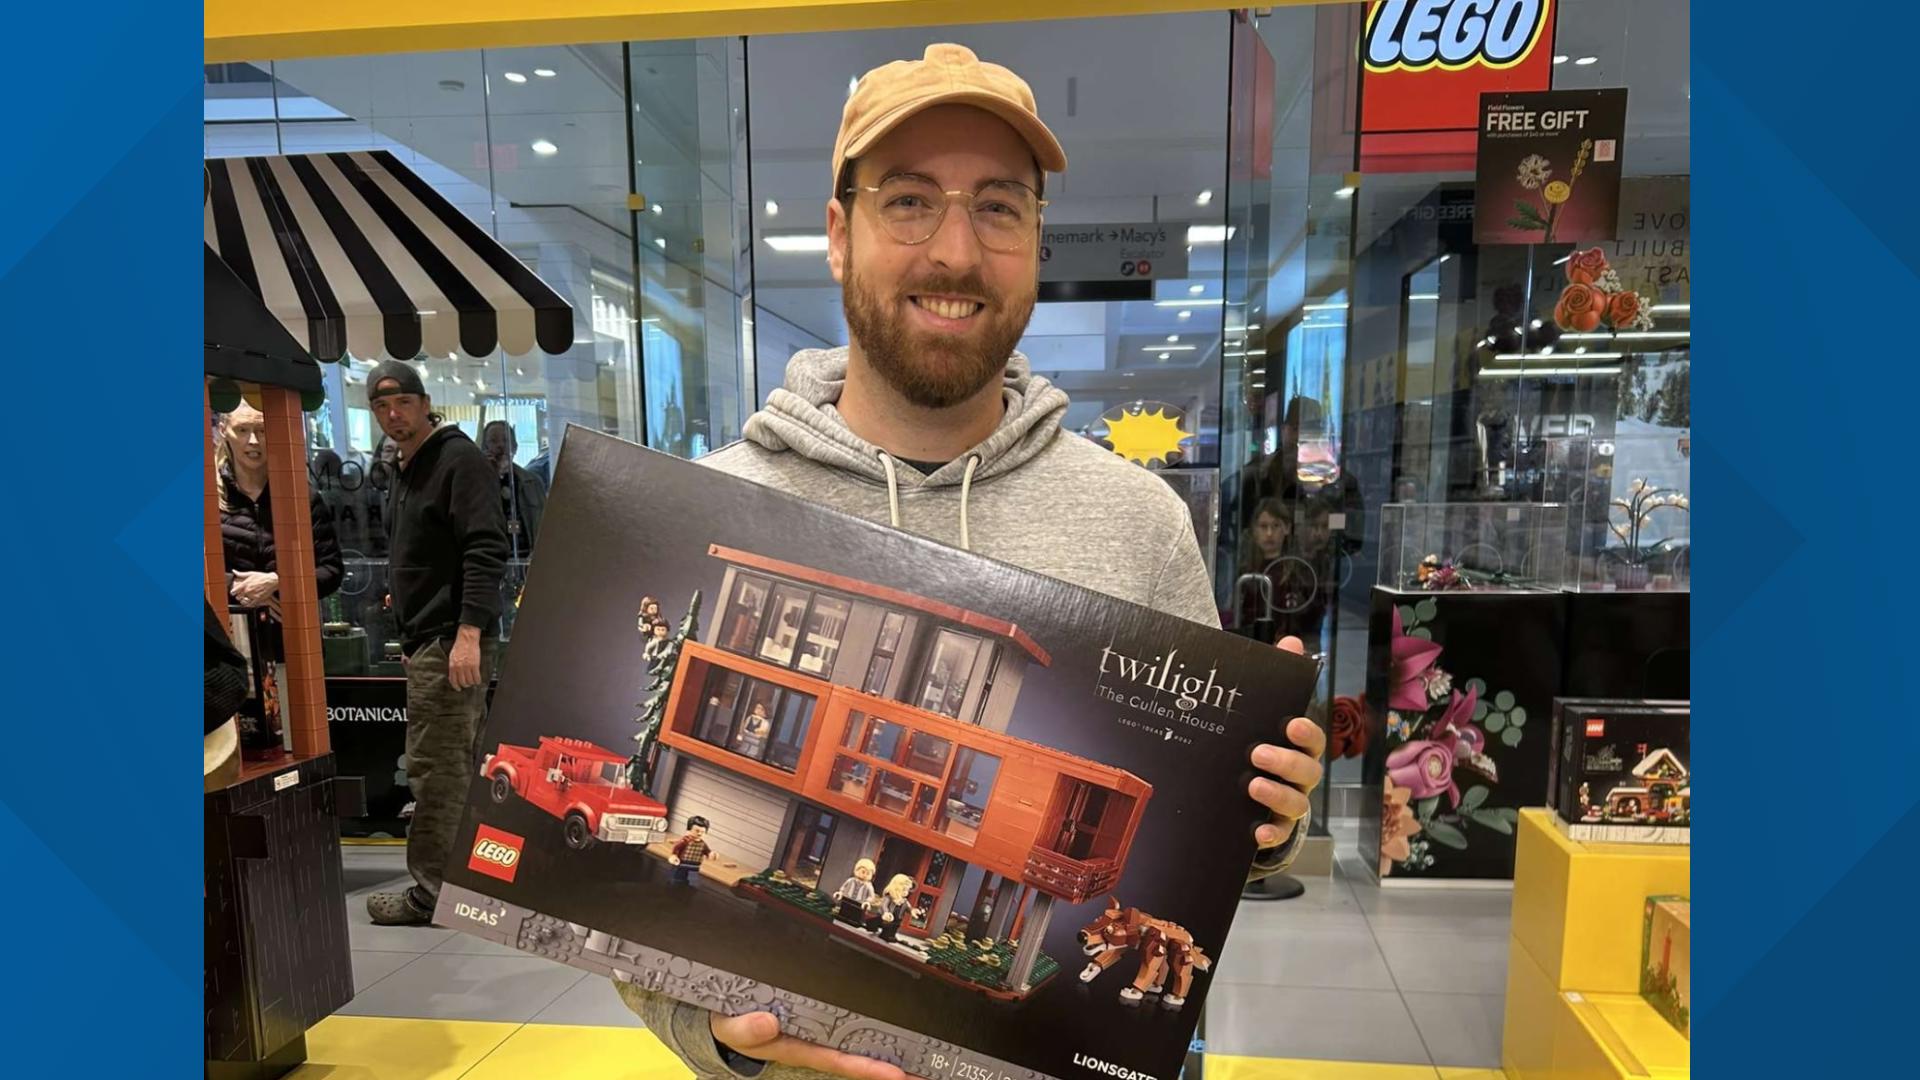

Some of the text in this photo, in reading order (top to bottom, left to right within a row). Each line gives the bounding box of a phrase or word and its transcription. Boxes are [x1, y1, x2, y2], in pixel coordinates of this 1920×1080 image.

[1365, 0, 1542, 66] LEGO
[1486, 109, 1590, 131] FREE GIFT
[1041, 227, 1166, 246] inemark Macy's
[1099, 648, 1243, 712] twilight
[326, 706, 409, 722] BOTANICAL
[1099, 684, 1226, 736] The Cullen House
[475, 839, 519, 867] LEGO
[454, 902, 498, 926] IDEAS
[930, 1053, 950, 1069] 18+
